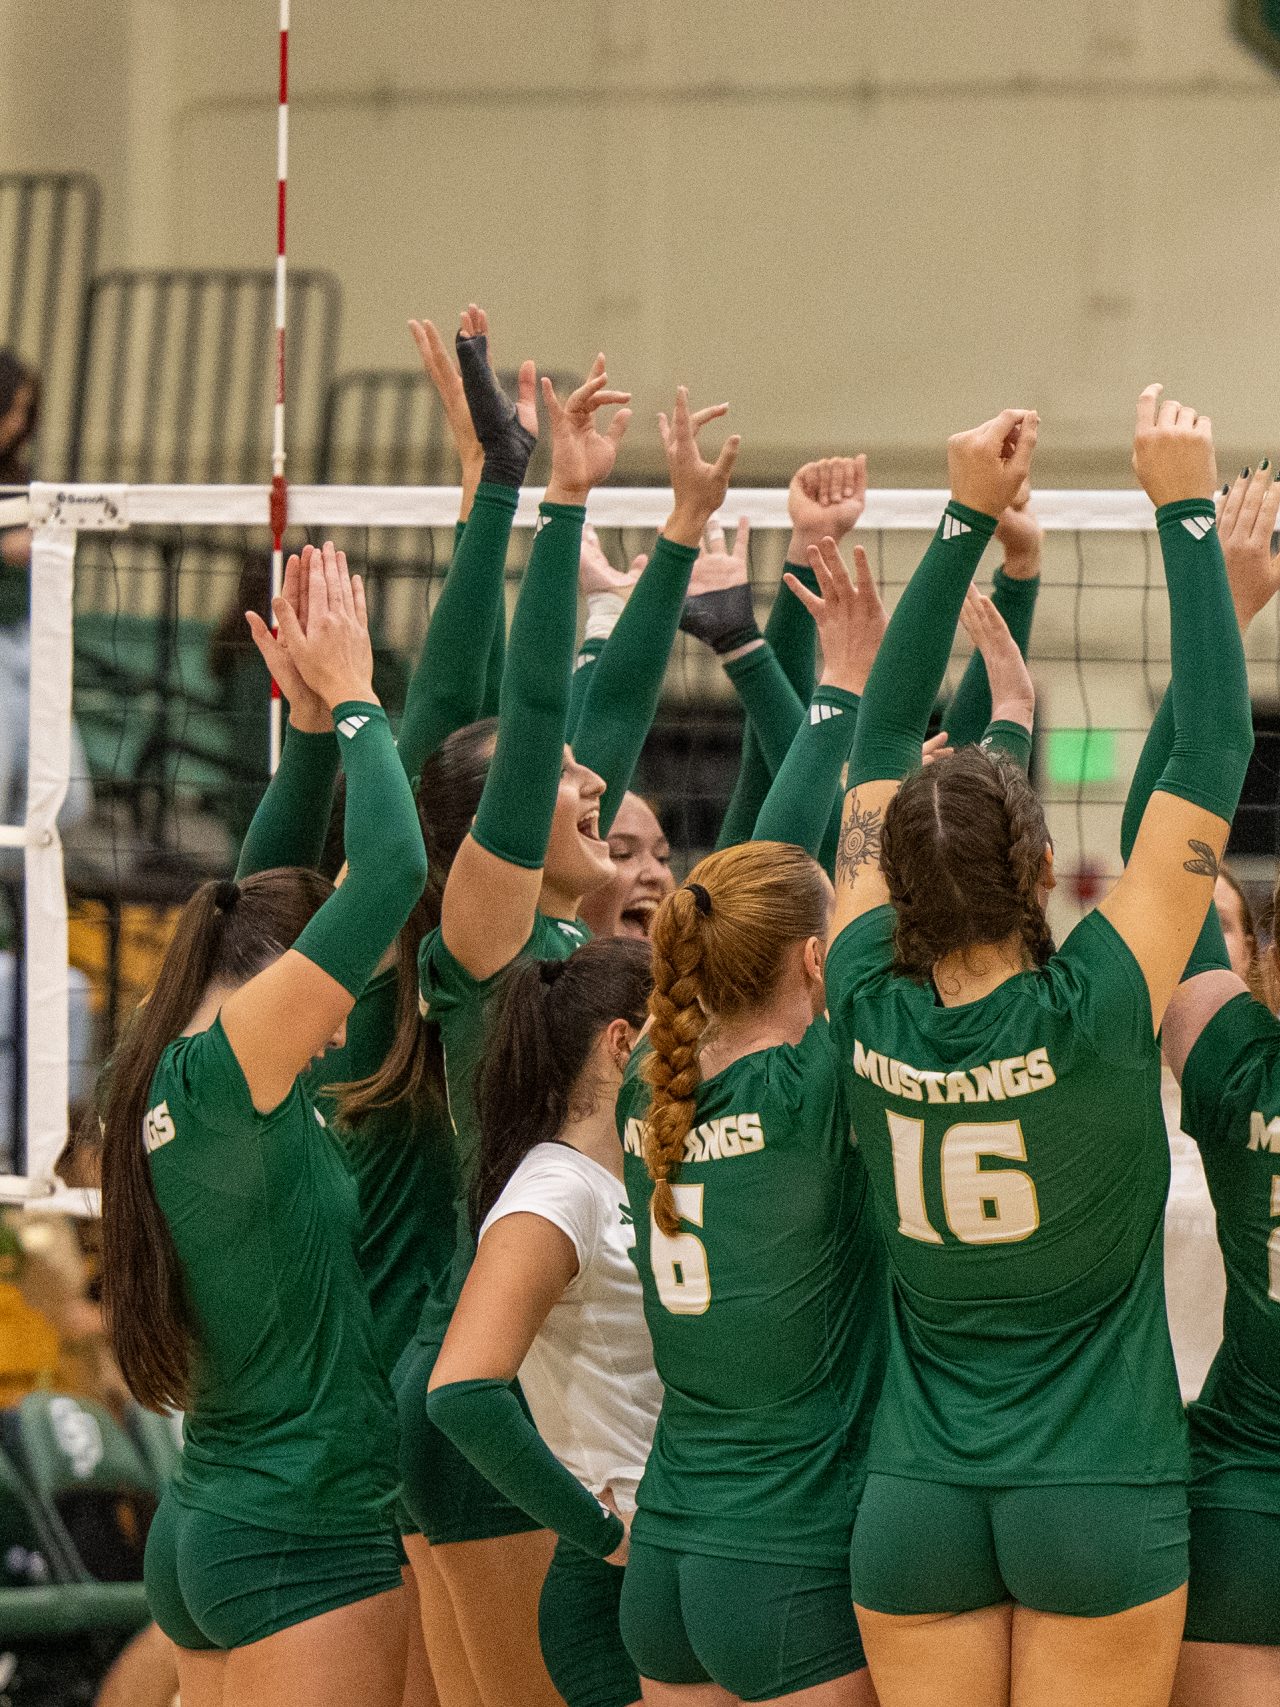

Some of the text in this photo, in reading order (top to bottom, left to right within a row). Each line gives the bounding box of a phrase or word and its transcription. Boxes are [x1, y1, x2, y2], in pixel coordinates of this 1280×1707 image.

[853, 1038, 1057, 1104] MUSTANGS
[624, 1112, 765, 1163] MANGS
[885, 1108, 1040, 1245] 16
[649, 1183, 712, 1315] 6
